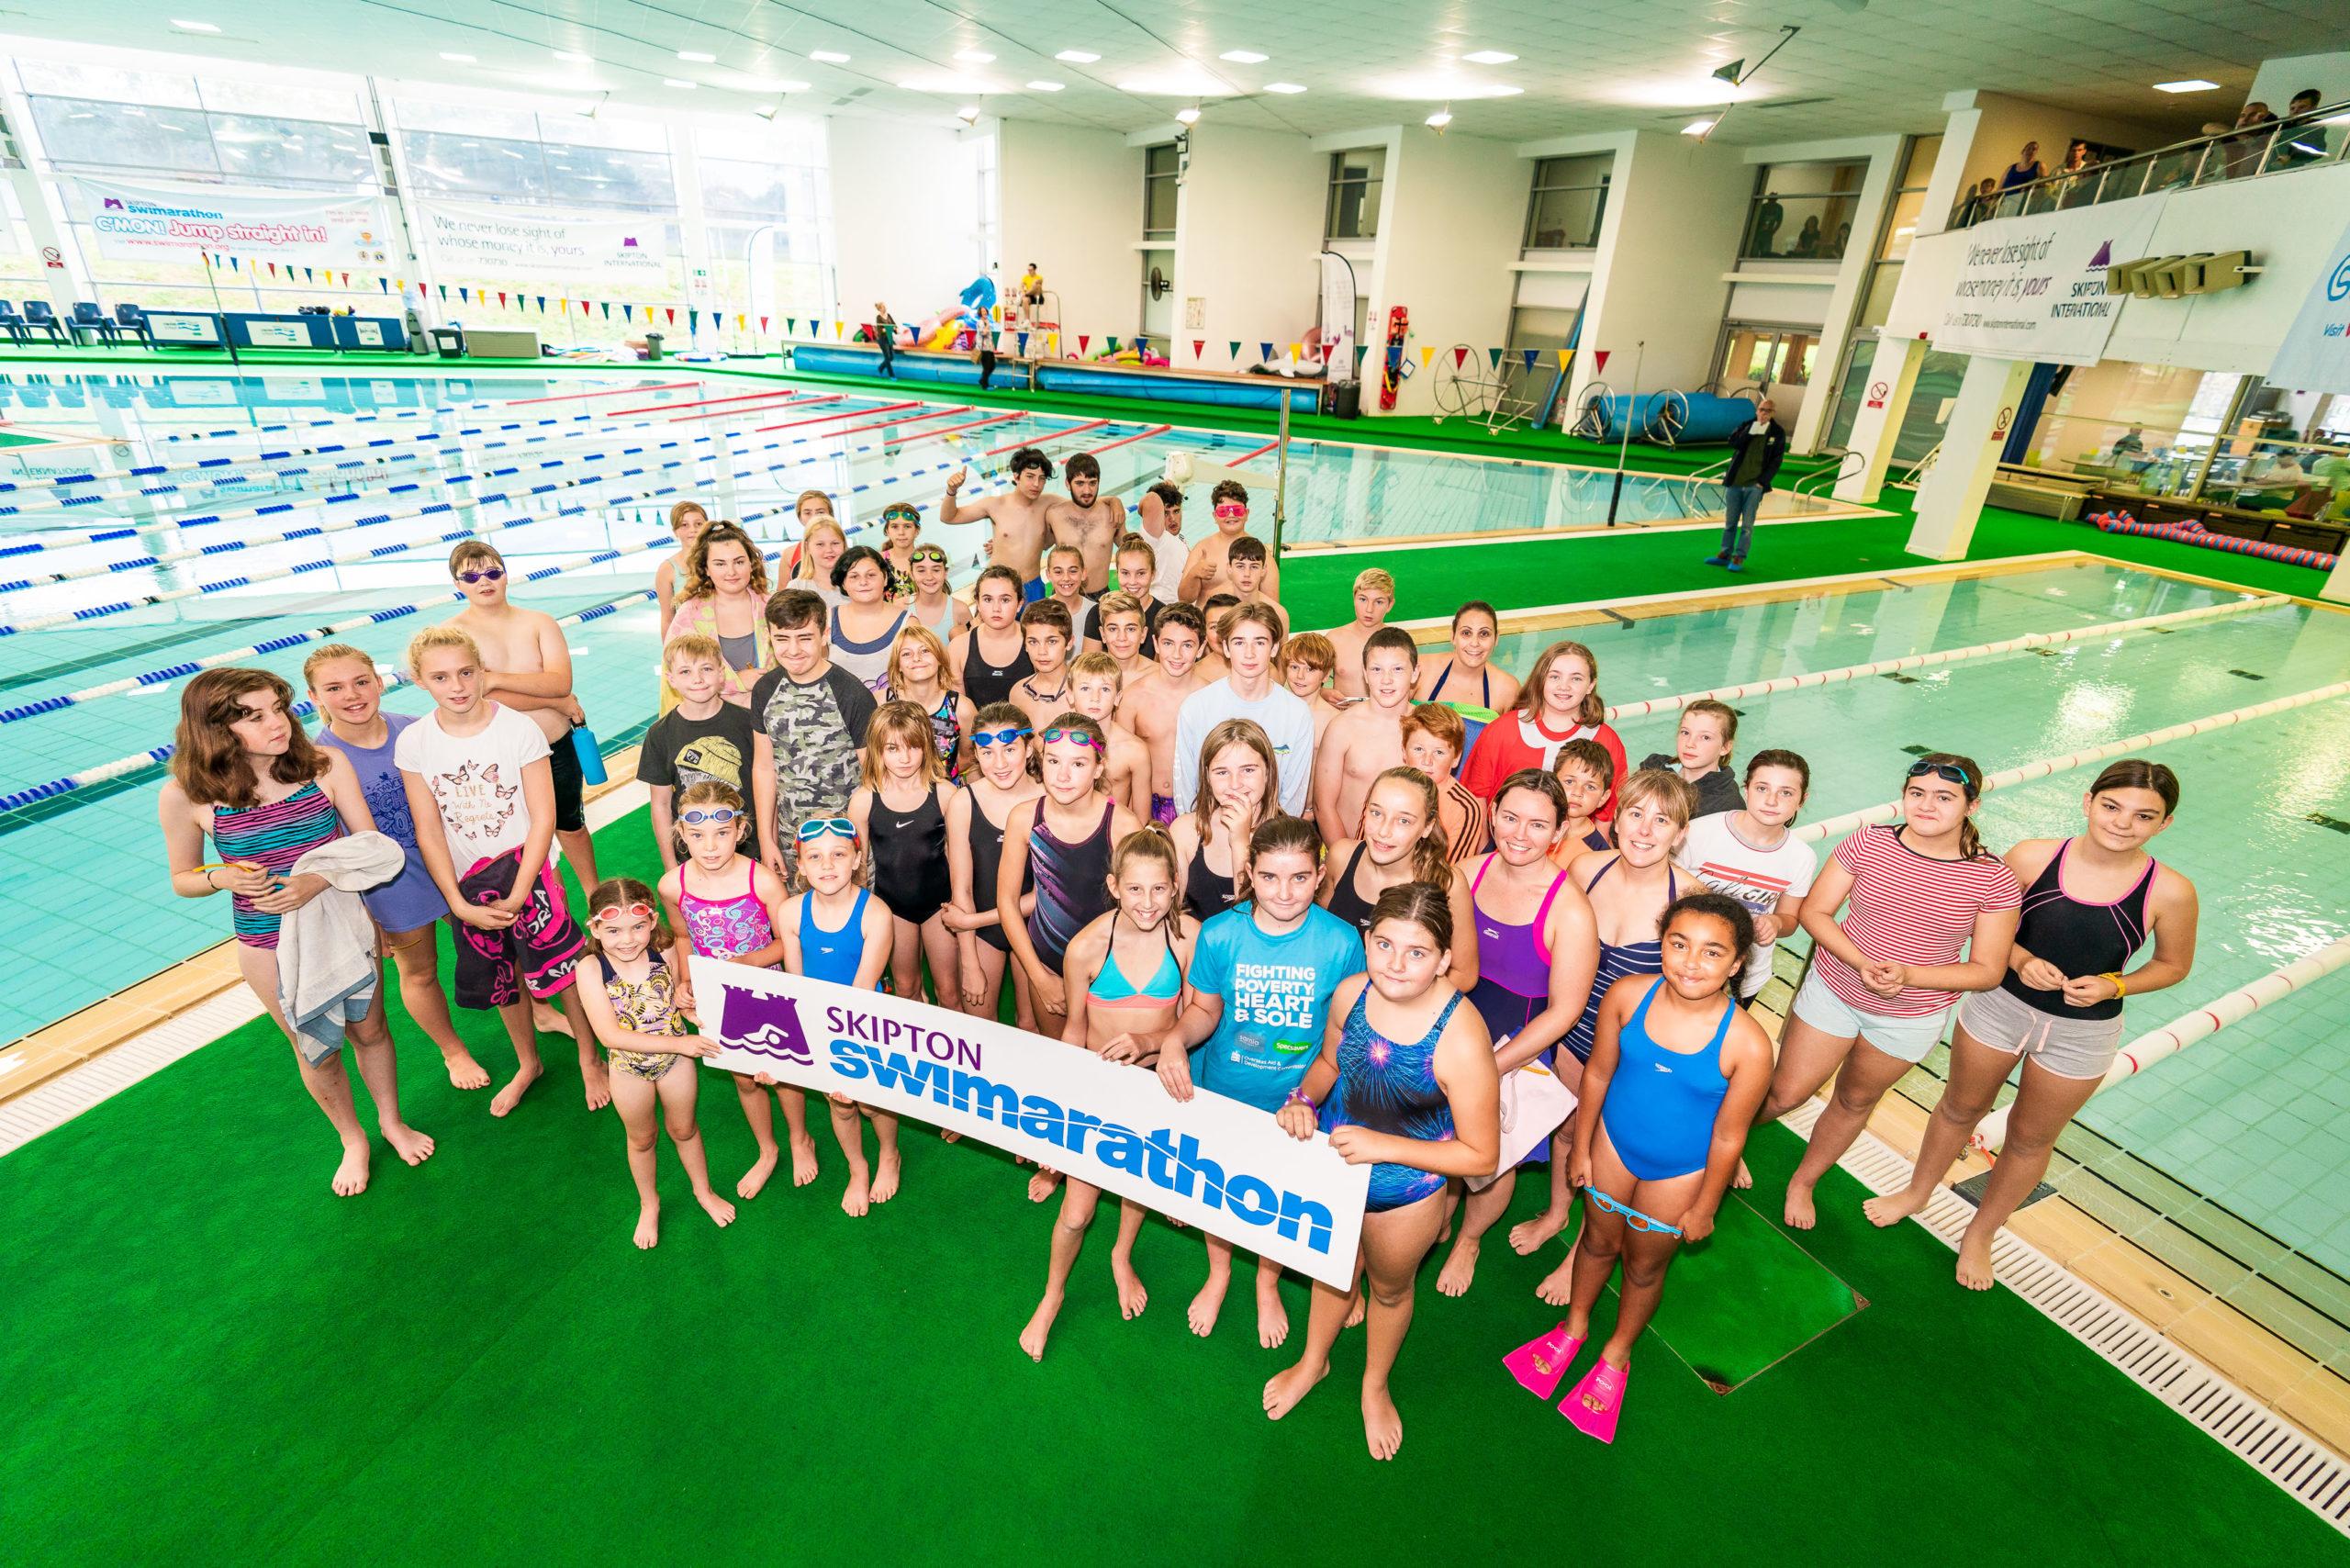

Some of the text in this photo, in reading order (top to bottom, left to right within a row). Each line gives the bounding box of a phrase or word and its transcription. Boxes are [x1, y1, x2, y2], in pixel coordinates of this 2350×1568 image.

[128, 204, 223, 219] swimarathon
[95, 216, 328, 246] C'MON! Jump straight in!
[433, 213, 566, 241] We never lose sight of
[437, 234, 478, 249] whose
[482, 241, 523, 255] money
[551, 245, 585, 258] yours
[2001, 239, 2019, 263] lose
[2017, 235, 2041, 269] sight
[2038, 231, 2056, 260] of
[2016, 276, 2053, 303] yours
[2070, 280, 2108, 297] SKIPTON
[2050, 302, 2111, 318] INTERNATIONAL
[2323, 323, 2345, 337] Visit
[455, 784, 486, 797] LIVE
[452, 800, 476, 809] With
[453, 812, 496, 825] Regrets
[1235, 963, 1315, 981] FIGHTING
[1235, 991, 1315, 1013] HEART
[1234, 1008, 1313, 1029] & SOLE
[827, 1006, 981, 1071] SKIPTON
[1239, 1035, 1259, 1046] sarnia
[1276, 1042, 1309, 1051] Specsavers
[1244, 1056, 1267, 1064] Overseas
[1244, 1060, 1277, 1071] Development
[829, 1039, 1333, 1254] swimarathon
